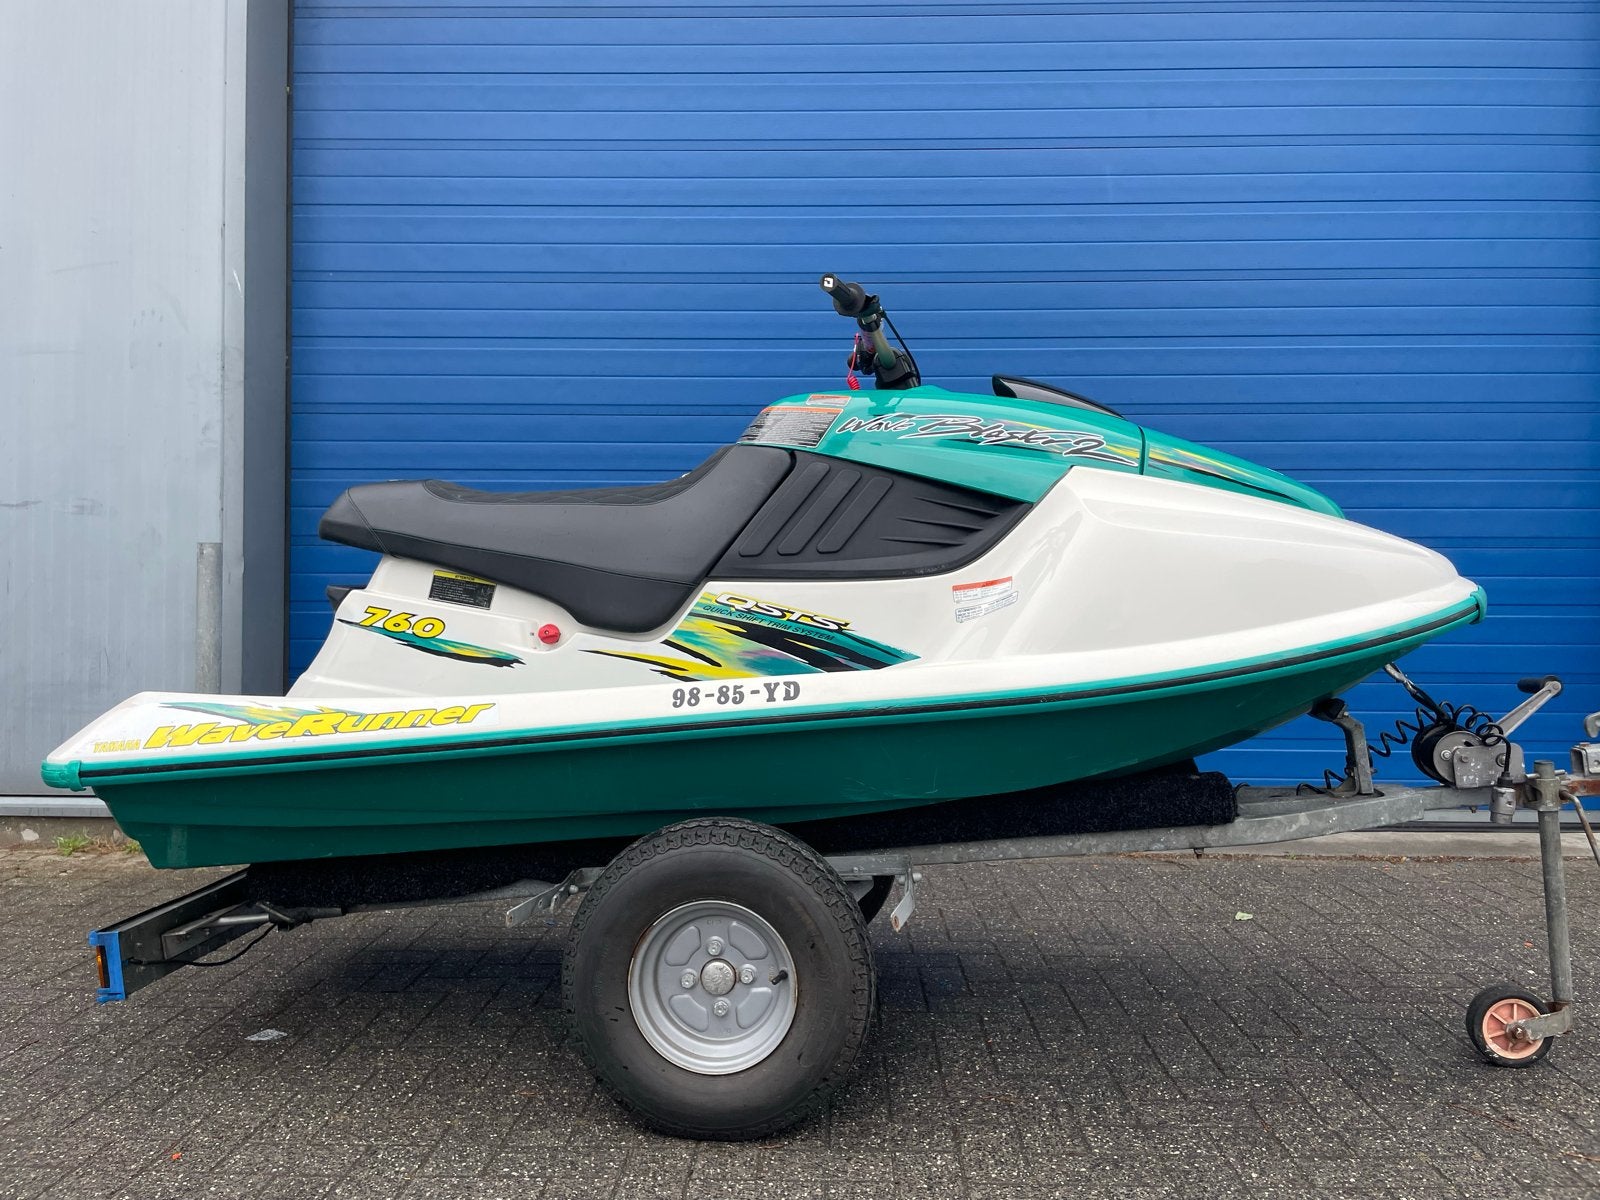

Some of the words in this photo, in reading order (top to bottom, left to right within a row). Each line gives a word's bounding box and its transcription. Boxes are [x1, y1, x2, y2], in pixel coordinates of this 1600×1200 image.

[359, 606, 446, 639] 760
[703, 604, 735, 617] QUICK
[735, 613, 767, 624] SHIFT
[767, 619, 793, 631] TRIM
[792, 627, 836, 641] SYSTEM
[715, 593, 849, 632] QSTS
[672, 681, 801, 708] 98-85-YD
[143, 703, 496, 749] WaveRunner
